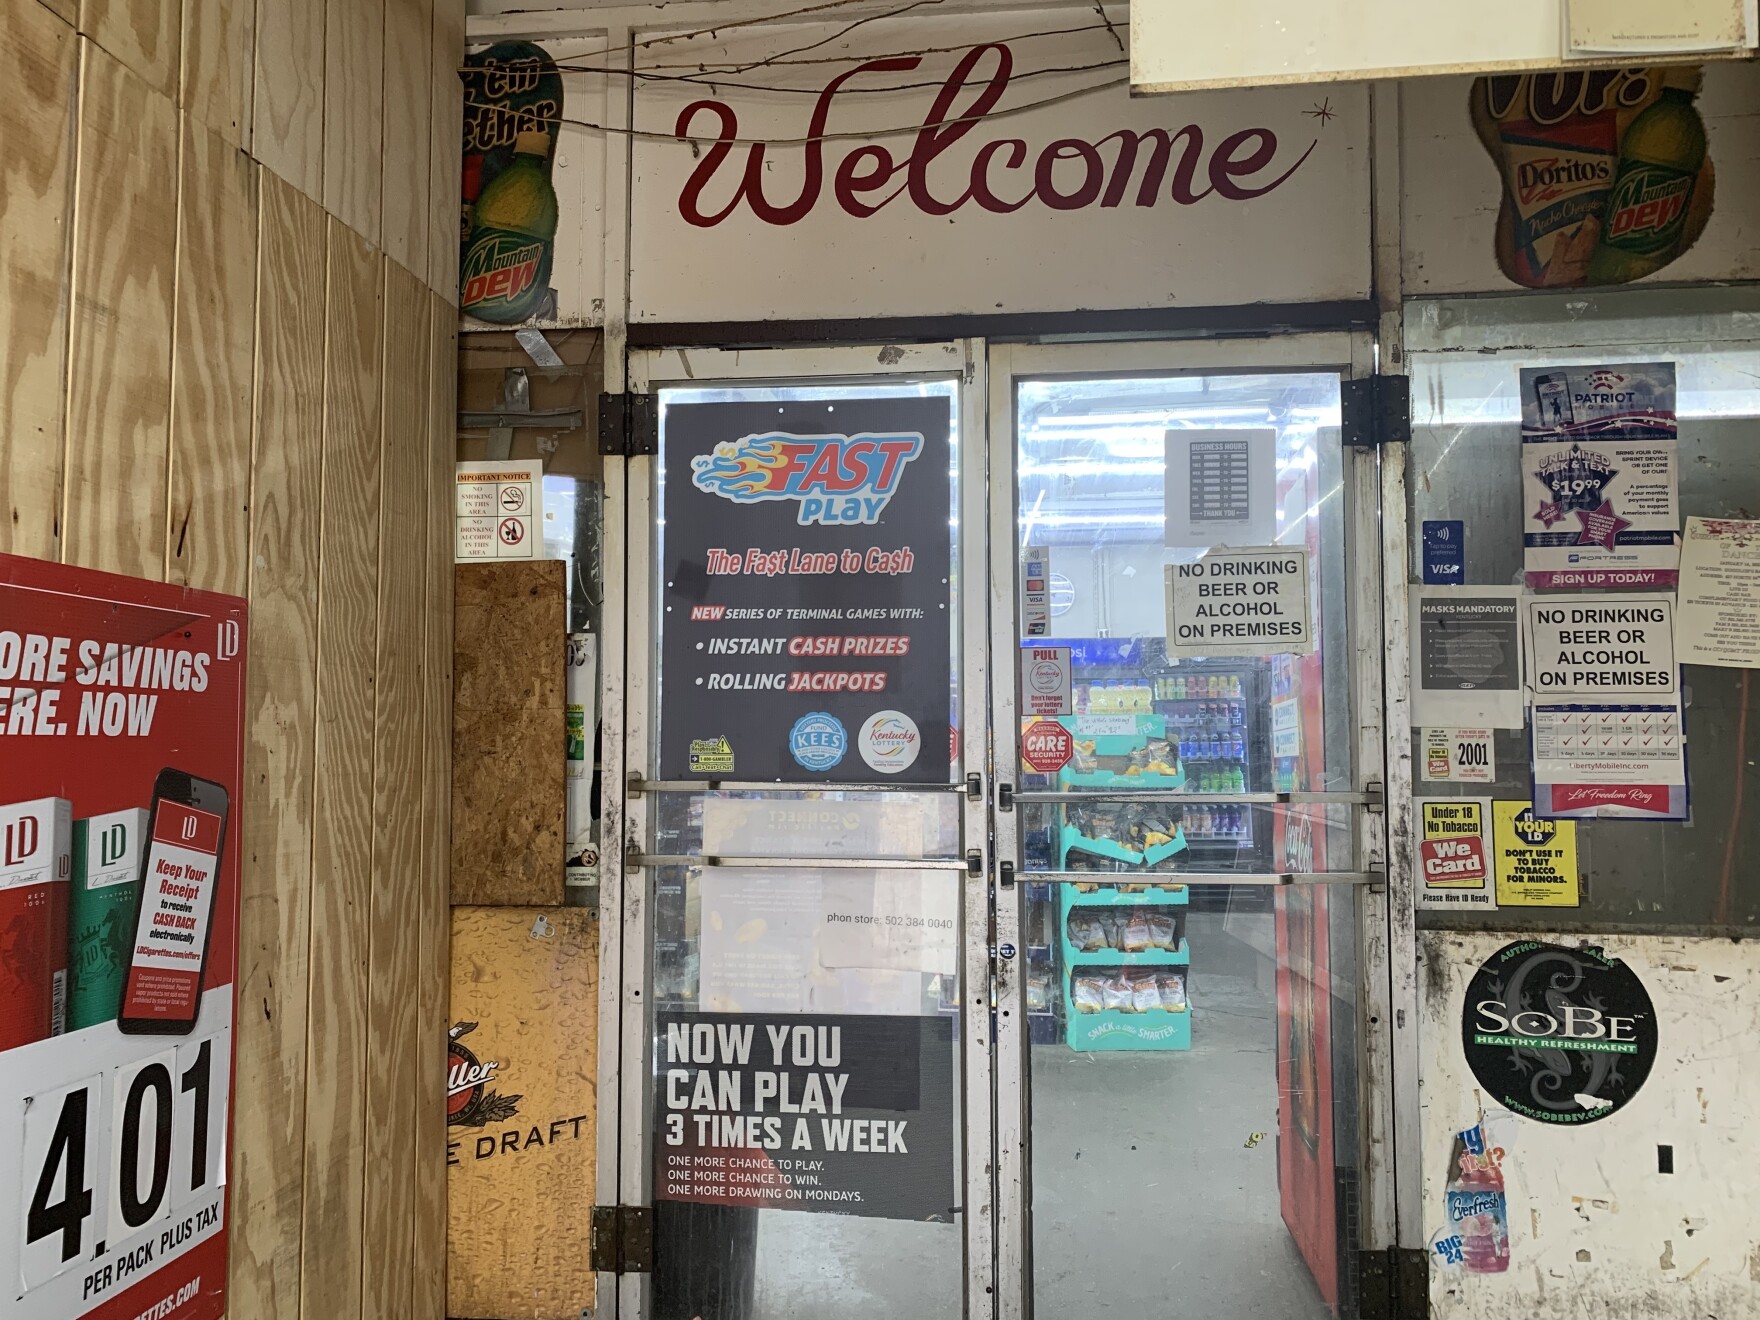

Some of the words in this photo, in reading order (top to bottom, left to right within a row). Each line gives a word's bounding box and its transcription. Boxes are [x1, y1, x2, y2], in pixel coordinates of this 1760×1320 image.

[675, 43, 1316, 228] Welcome
[1520, 159, 1610, 189] Doritos
[1611, 172, 1688, 210] Mountain
[1610, 192, 1684, 238] DEW
[466, 241, 544, 278] Mountain
[462, 256, 542, 305] DEW
[1575, 392, 1635, 403] PATRIOT
[1192, 443, 1224, 451] BUSINESS
[1225, 442, 1247, 450] HOURS
[765, 442, 914, 491] FAST
[1540, 450, 1610, 467] UNLIMITED
[1540, 461, 1568, 476] TALK
[1571, 461, 1580, 469] &
[1583, 461, 1610, 475] TEXT
[707, 549, 741, 574] The
[789, 548, 834, 574] Lane
[841, 549, 862, 574] to
[1179, 563, 1204, 577] NO
[1210, 560, 1297, 576] DRINKING
[1430, 565, 1459, 573] VISA
[1552, 575, 1585, 583] SIGN
[1588, 574, 1605, 583] UP
[1608, 574, 1654, 583] TODAY!
[1198, 583, 1247, 597] BEER
[1252, 581, 1279, 595] OR
[691, 607, 723, 620] NEW
[725, 608, 764, 620] SERIES
[766, 608, 783, 619] OF
[786, 608, 843, 620] TERMINAL
[846, 608, 887, 619] GAMES
[890, 608, 924, 619] WITH:
[1195, 601, 1283, 617] ALCOHOL
[1456, 605, 1515, 613] MANDATORY
[1538, 610, 1565, 623] NO
[1572, 608, 1664, 623] DRINKING
[1179, 624, 1204, 638] ON
[1210, 622, 1302, 638] PREMISES
[1559, 630, 1612, 644] BEER
[1616, 629, 1645, 644] OR
[217, 620, 239, 661] LD
[708, 638, 786, 654] INSTANT
[789, 637, 840, 654] CASH
[843, 637, 909, 654] PRIZES
[1033, 650, 1058, 660] PULL
[1557, 650, 1650, 665] ALCOHOL
[76, 640, 211, 692] SAVINGS
[1035, 670, 1059, 678] Kentucky
[708, 673, 786, 690] ROLLING
[788, 673, 886, 690] JACKPOTS
[1540, 671, 1567, 686] ON
[1573, 671, 1669, 685] PREMISES
[77, 691, 158, 736] NOW
[798, 733, 840, 747] KEES
[870, 729, 916, 743] Kentucky
[1027, 736, 1067, 751] CARE
[1458, 743, 1488, 765] 2001
[1569, 762, 1648, 770] LibertyMobileInc.com
[1568, 789, 1588, 801] Let
[1588, 789, 1626, 800] Freedom
[1628, 789, 1652, 803] Ring
[1431, 807, 1459, 819] Under
[1462, 807, 1472, 818] 18
[182, 815, 197, 840] LD
[1427, 821, 1440, 832] No
[1442, 821, 1478, 833] Tobacco
[1515, 821, 1554, 833] YOUR
[5, 816, 38, 866] LD
[101, 823, 126, 867] LD
[1433, 841, 1471, 858] We
[1505, 849, 1533, 857] DON'T
[1535, 849, 1552, 857] USE
[156, 859, 183, 880] Keep
[184, 864, 208, 882] Your
[1426, 855, 1482, 875] Card
[1516, 858, 1529, 866] TO
[1531, 858, 1550, 866] BUY
[1527, 875, 1567, 883] MINORS.
[159, 879, 199, 901] Receipt
[1423, 894, 1444, 902] Please
[1445, 894, 1460, 902] Have
[1461, 894, 1469, 902] ID
[1470, 894, 1489, 903] Ready
[161, 899, 167, 909] to
[168, 902, 192, 913] receive
[153, 912, 175, 928] CASH
[175, 916, 197, 930] BACK
[827, 912, 852, 925] phon
[854, 915, 882, 925] store:
[885, 915, 904, 926] 502
[906, 917, 925, 927] 384
[927, 918, 953, 930] 0040
[149, 929, 195, 944] electronically
[1088, 1022, 1114, 1040] SNACK
[667, 1023, 754, 1064] NOW
[766, 1025, 841, 1067] YOU
[1477, 1036, 1537, 1046] HEALTHY
[1541, 1040, 1637, 1052] REFRESHMENT
[666, 1069, 741, 1112] CAN
[754, 1071, 849, 1114] PLAY
[475, 1115, 587, 1160] DRAFT
[666, 1114, 684, 1146] 3
[693, 1114, 782, 1150] TIMES
[791, 1118, 812, 1150] A
[821, 1119, 908, 1153] WEEK
[26, 1039, 211, 1263] 4.01
[668, 1155, 691, 1166] ONE
[694, 1156, 726, 1168] MORE
[729, 1157, 774, 1170] CHANCE
[778, 1159, 792, 1170] TO
[795, 1160, 825, 1171] PLAY.
[668, 1170, 691, 1181] ONE
[694, 1171, 726, 1182] MORE
[729, 1172, 774, 1184] CHANCE
[778, 1174, 792, 1185] TO
[795, 1174, 821, 1185] WIN.
[668, 1184, 691, 1195] ONE
[694, 1185, 726, 1197] MORE
[729, 1186, 782, 1199] DRAWING
[785, 1189, 802, 1200] ON
[805, 1190, 864, 1202] MONDAYS.
[1453, 1192, 1500, 1221] Everfresh
[83, 1265, 111, 1300] PER
[116, 1240, 154, 1281] PACK
[160, 1219, 193, 1254] PLUS
[196, 1202, 219, 1232] TAX
[1435, 1234, 1463, 1254] BIG
[1444, 1249, 1463, 1264] 24
